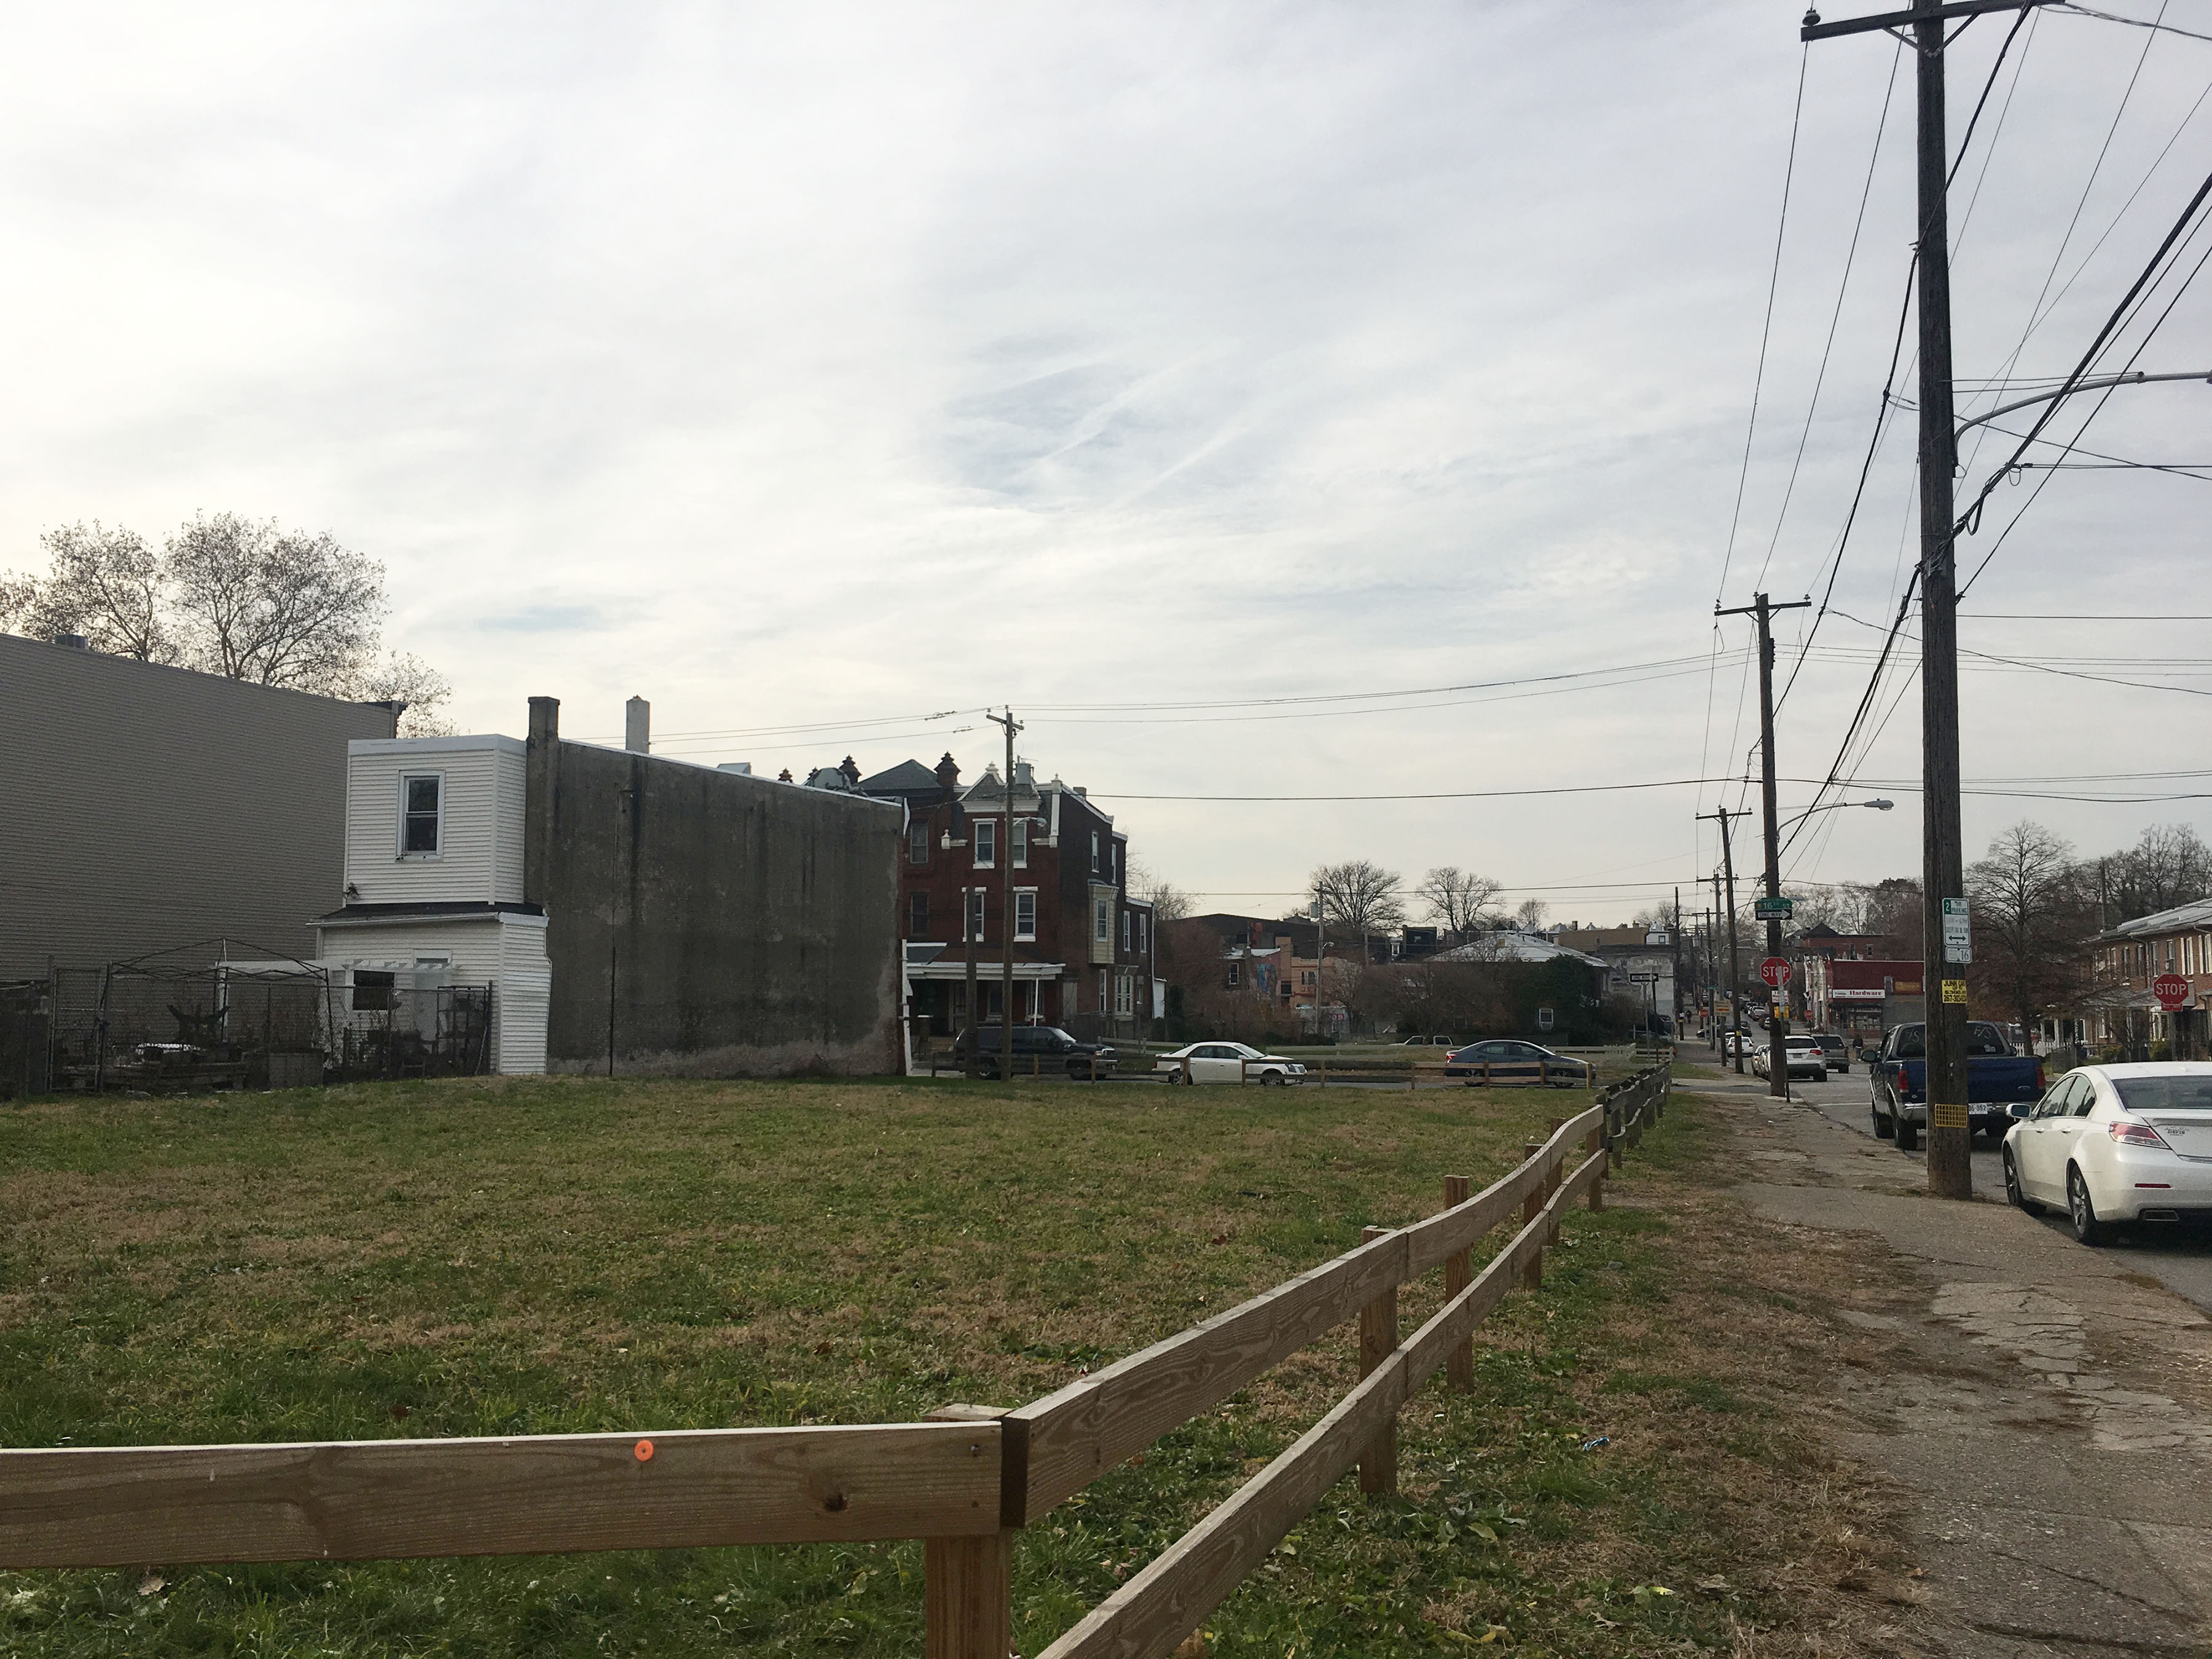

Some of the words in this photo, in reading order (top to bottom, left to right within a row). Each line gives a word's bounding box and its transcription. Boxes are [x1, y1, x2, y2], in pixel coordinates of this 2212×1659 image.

[1945, 902, 1950, 911] 2
[1961, 951, 1969, 960] 16
[2156, 983, 2186, 995] STOP
